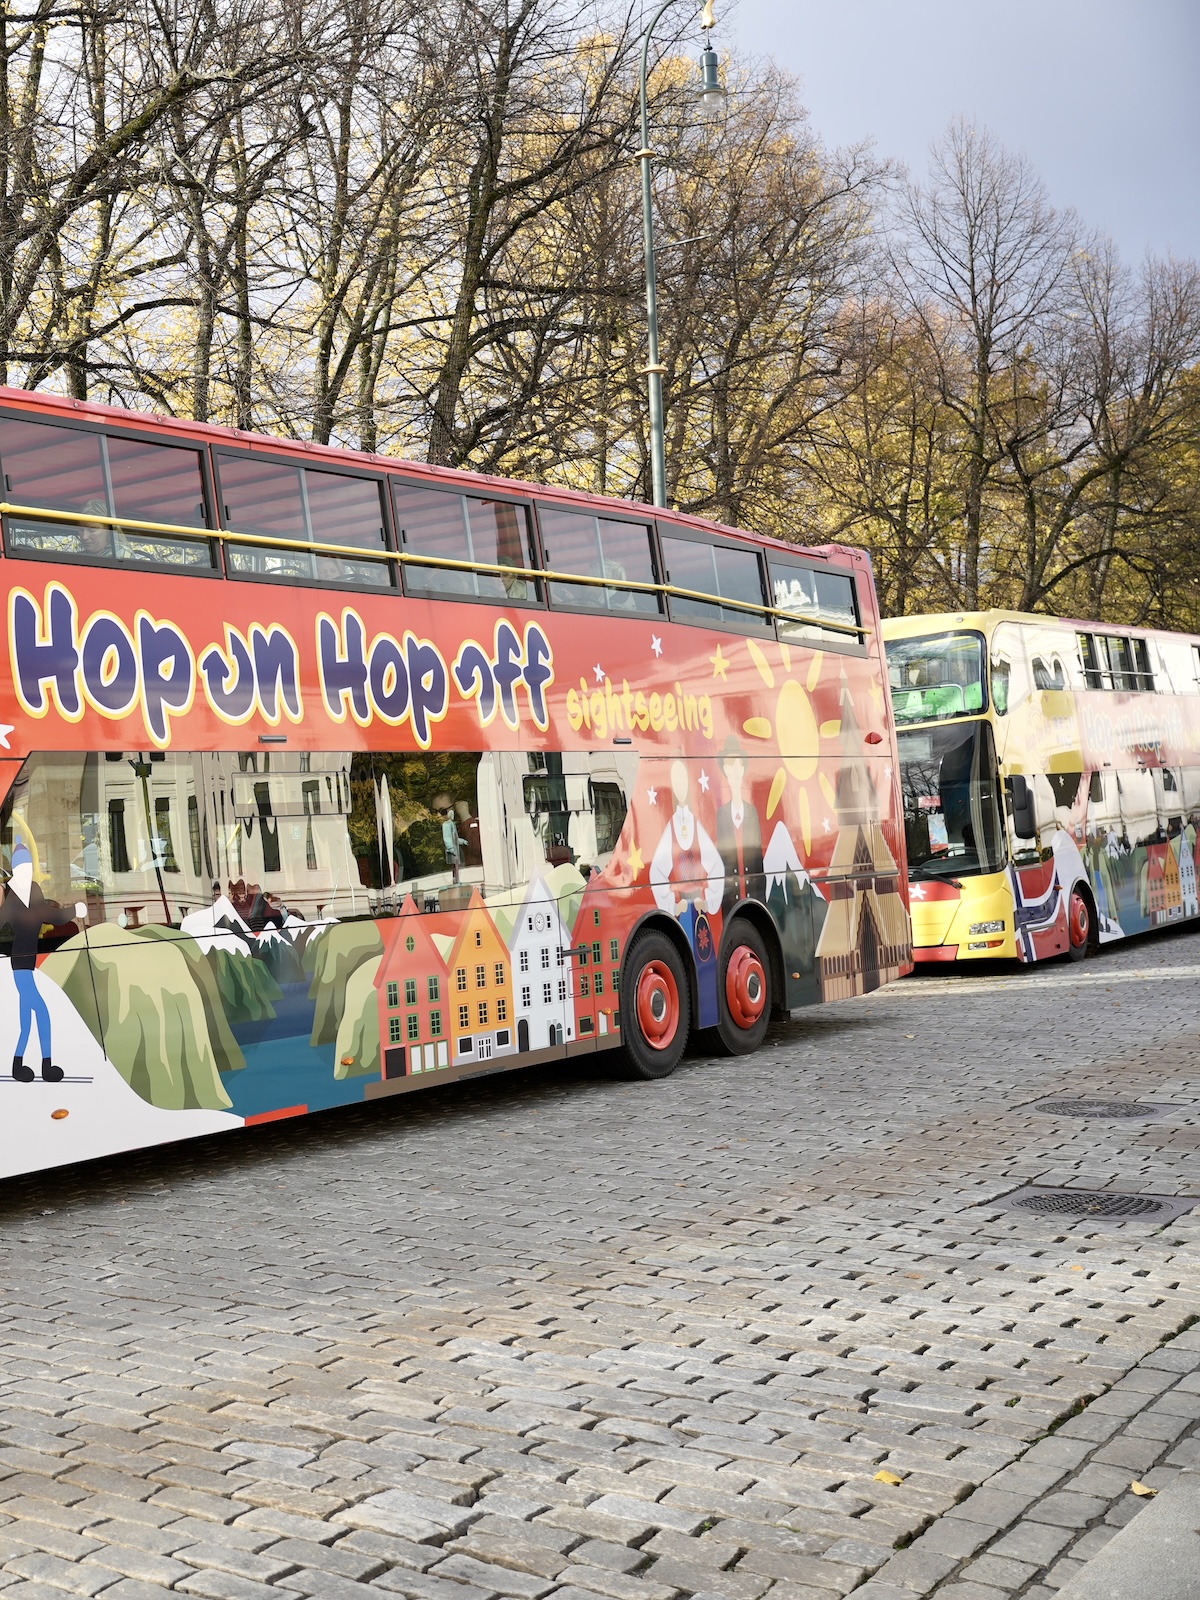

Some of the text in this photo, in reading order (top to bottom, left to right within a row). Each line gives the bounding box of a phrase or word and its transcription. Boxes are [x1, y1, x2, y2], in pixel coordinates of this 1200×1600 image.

[7, 580, 197, 749] Hop
[315, 606, 451, 750] Hop
[451, 617, 555, 732] off
[566, 676, 714, 740] sightseeing
